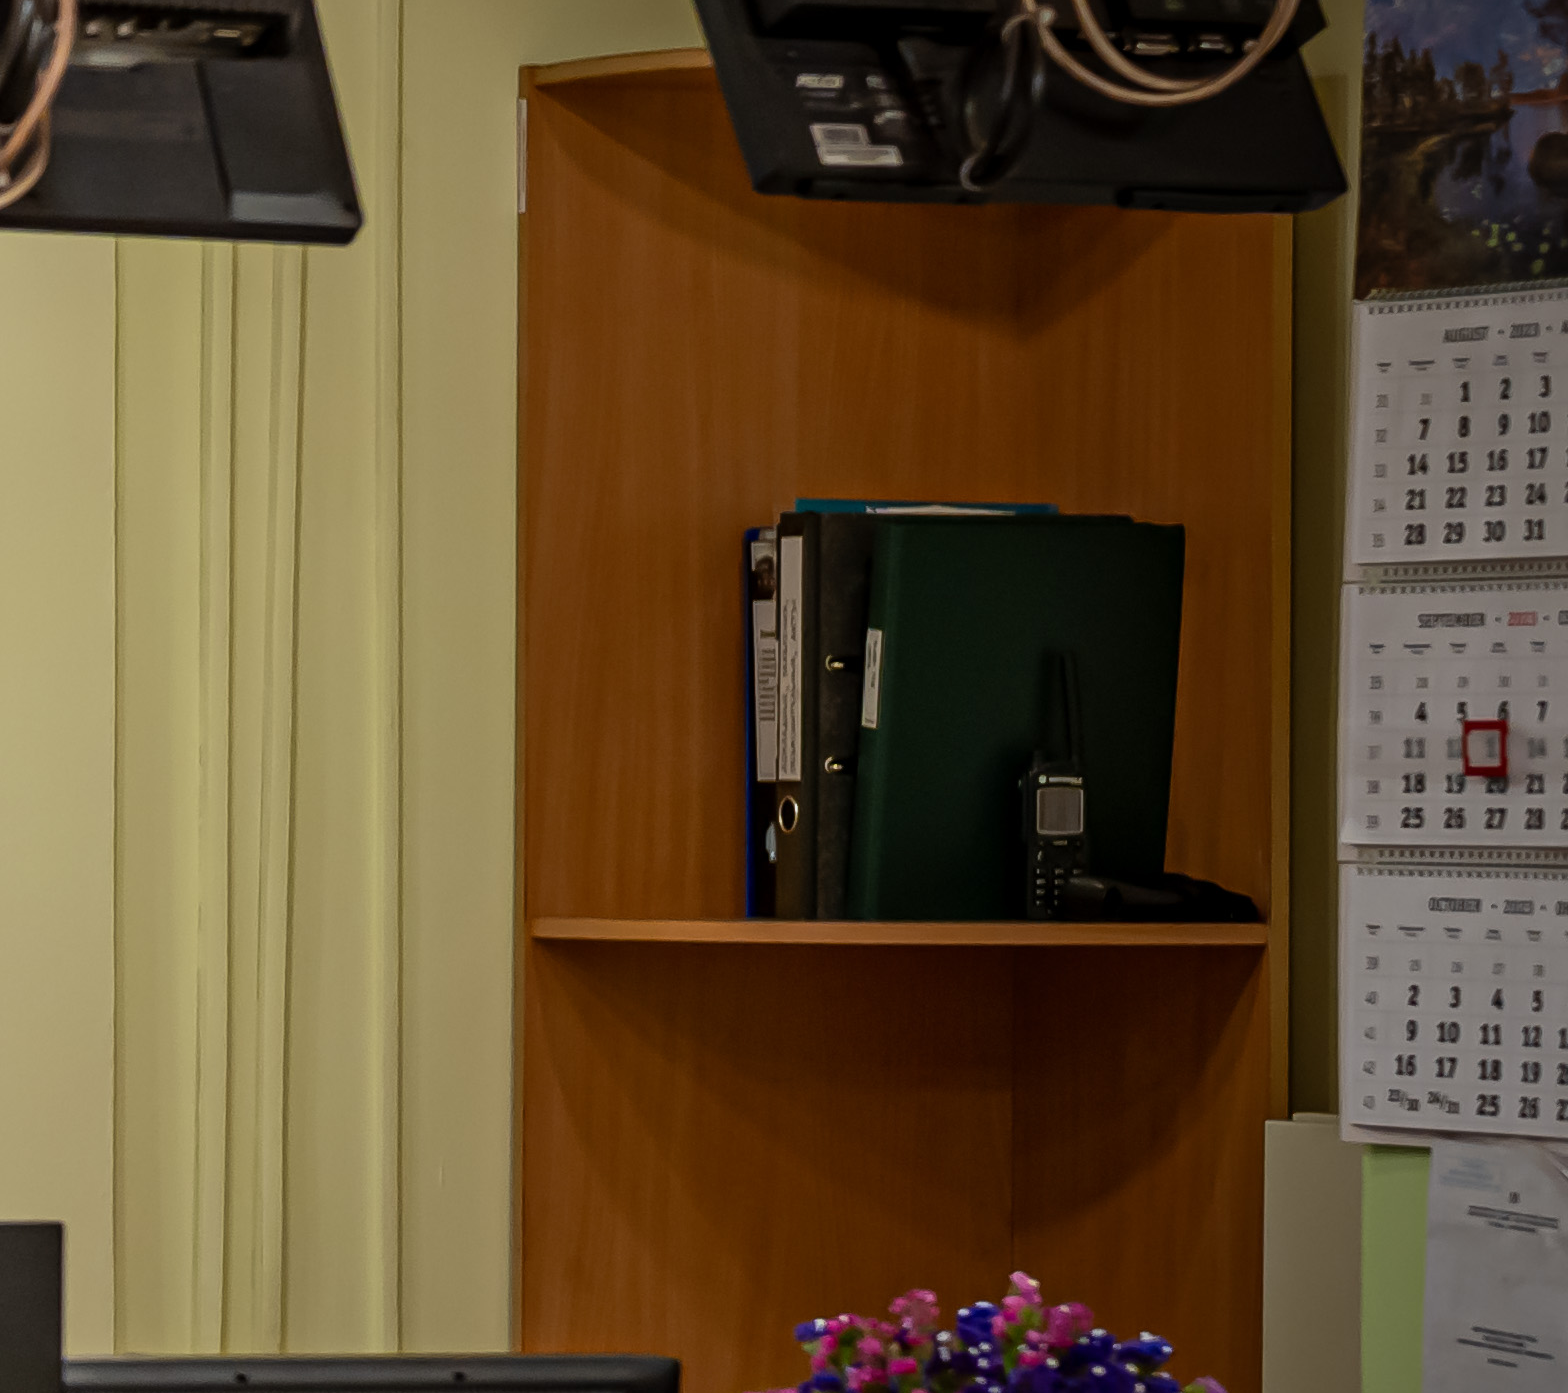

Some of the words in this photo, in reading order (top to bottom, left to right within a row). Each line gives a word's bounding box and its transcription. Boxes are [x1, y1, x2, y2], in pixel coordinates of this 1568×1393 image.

[1460, 382, 1470, 402] 1
[1500, 378, 1511, 400] 2
[1539, 375, 1551, 398] 3
[1419, 418, 1430, 440] 7
[1458, 416, 1470, 438] 8
[1498, 414, 1509, 435] 9
[1528, 411, 1551, 434] 10
[1408, 454, 1428, 475] 14
[1447, 451, 1468, 473] 15
[1487, 449, 1508, 471] 16
[1527, 447, 1547, 469] 17
[1406, 489, 1426, 510] 21
[1445, 487, 1467, 509] 22
[1485, 485, 1506, 507] 23
[1526, 483, 1546, 505] 24
[1405, 524, 1426, 545] 28
[1443, 522, 1465, 544] 29
[1483, 520, 1506, 542] 30
[1524, 519, 1544, 541] 31
